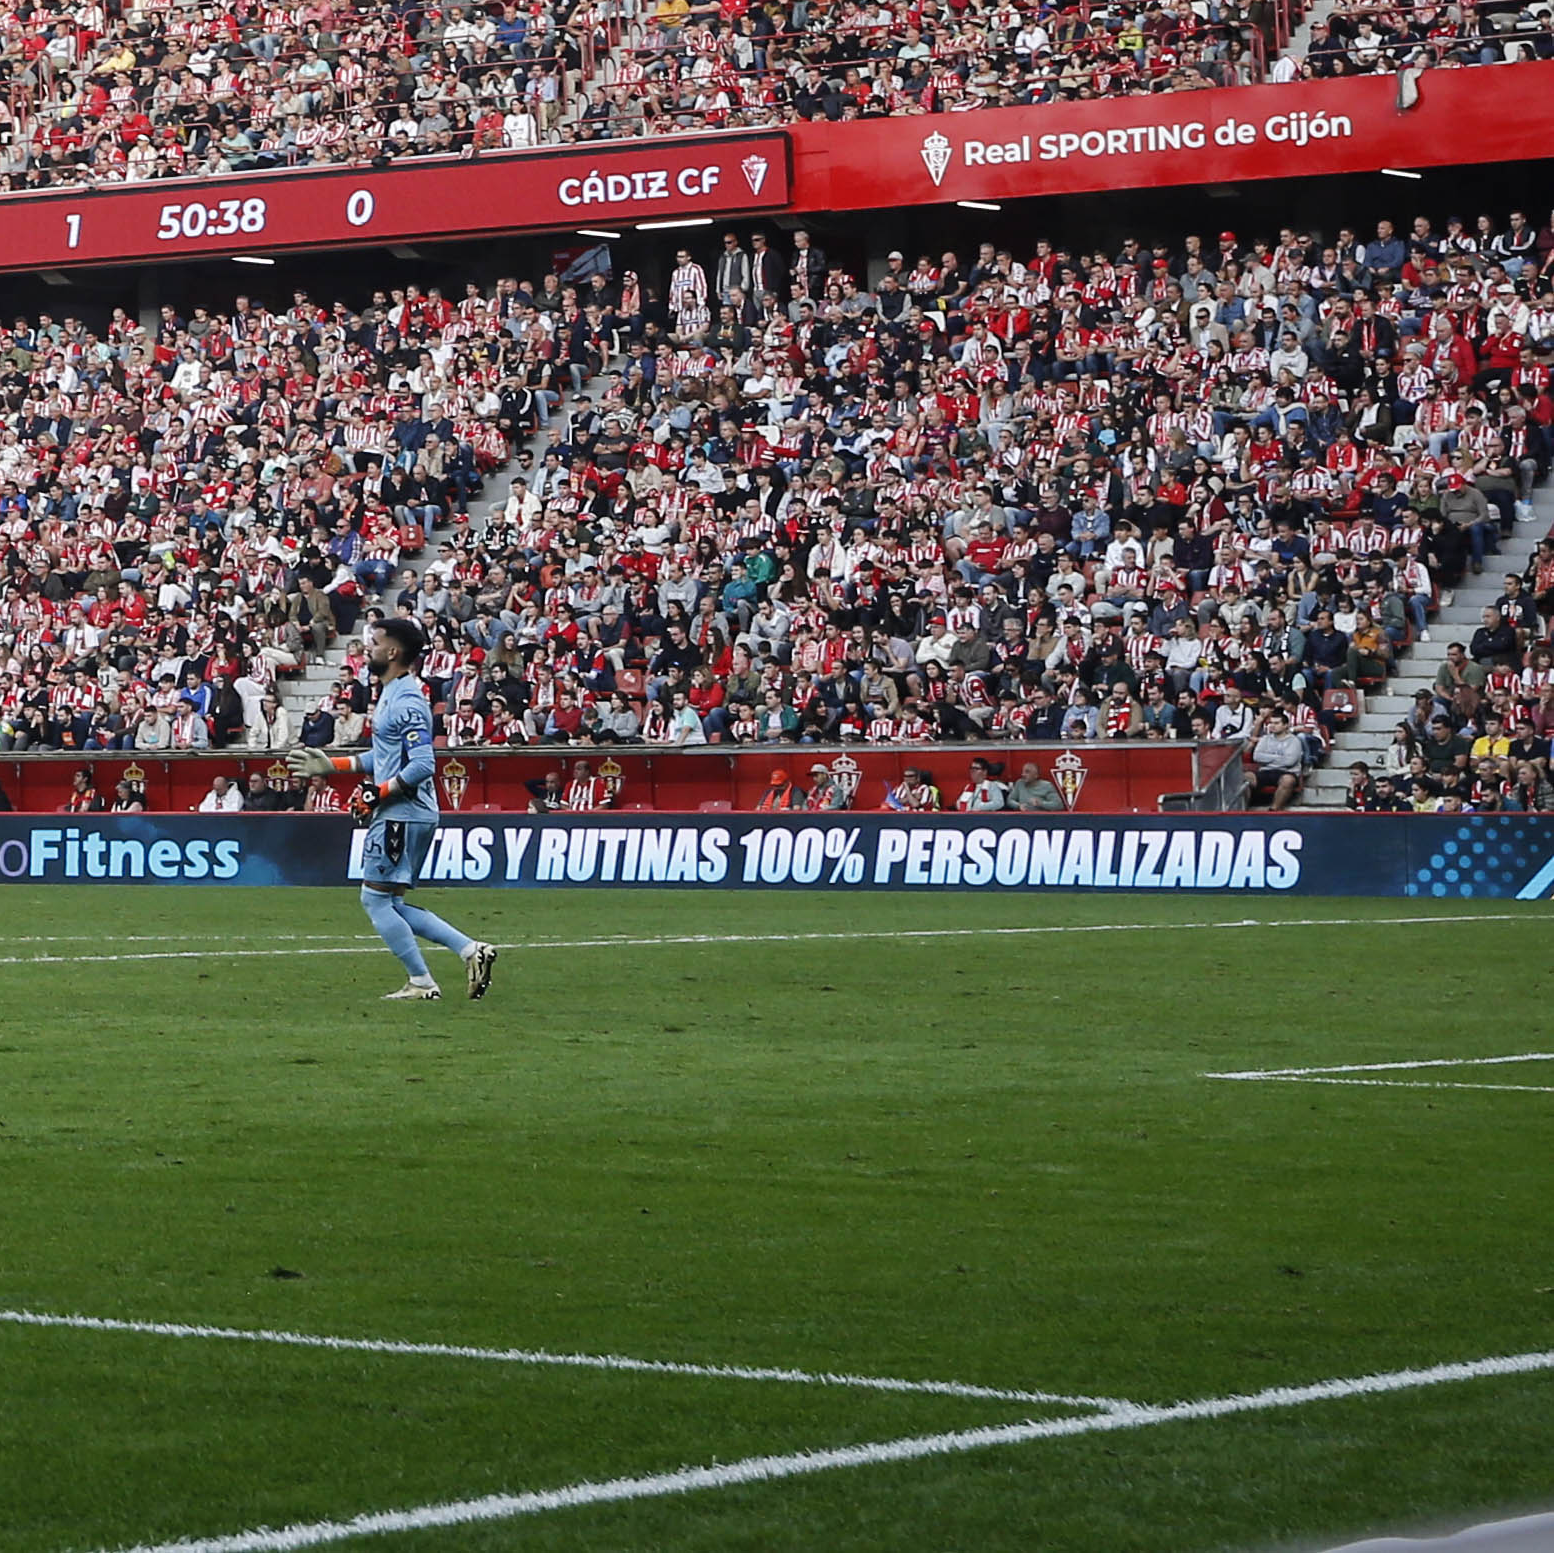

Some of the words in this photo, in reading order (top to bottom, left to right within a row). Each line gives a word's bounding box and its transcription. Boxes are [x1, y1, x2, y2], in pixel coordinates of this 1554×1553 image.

[964, 135, 1030, 166] Real
[1038, 121, 1205, 160] SPORTING
[1214, 116, 1257, 145] de
[1262, 111, 1352, 149] Gijón
[64, 214, 81, 249] 1
[156, 198, 266, 241] 50:38
[346, 189, 374, 227] 0
[557, 165, 669, 207] CÁDIZ
[677, 165, 719, 198] CF
[502, 827, 535, 881] Y
[535, 826, 731, 884] RUTINAS
[738, 827, 865, 886] 100%
[873, 827, 1303, 889] PERSONALIZADAS
